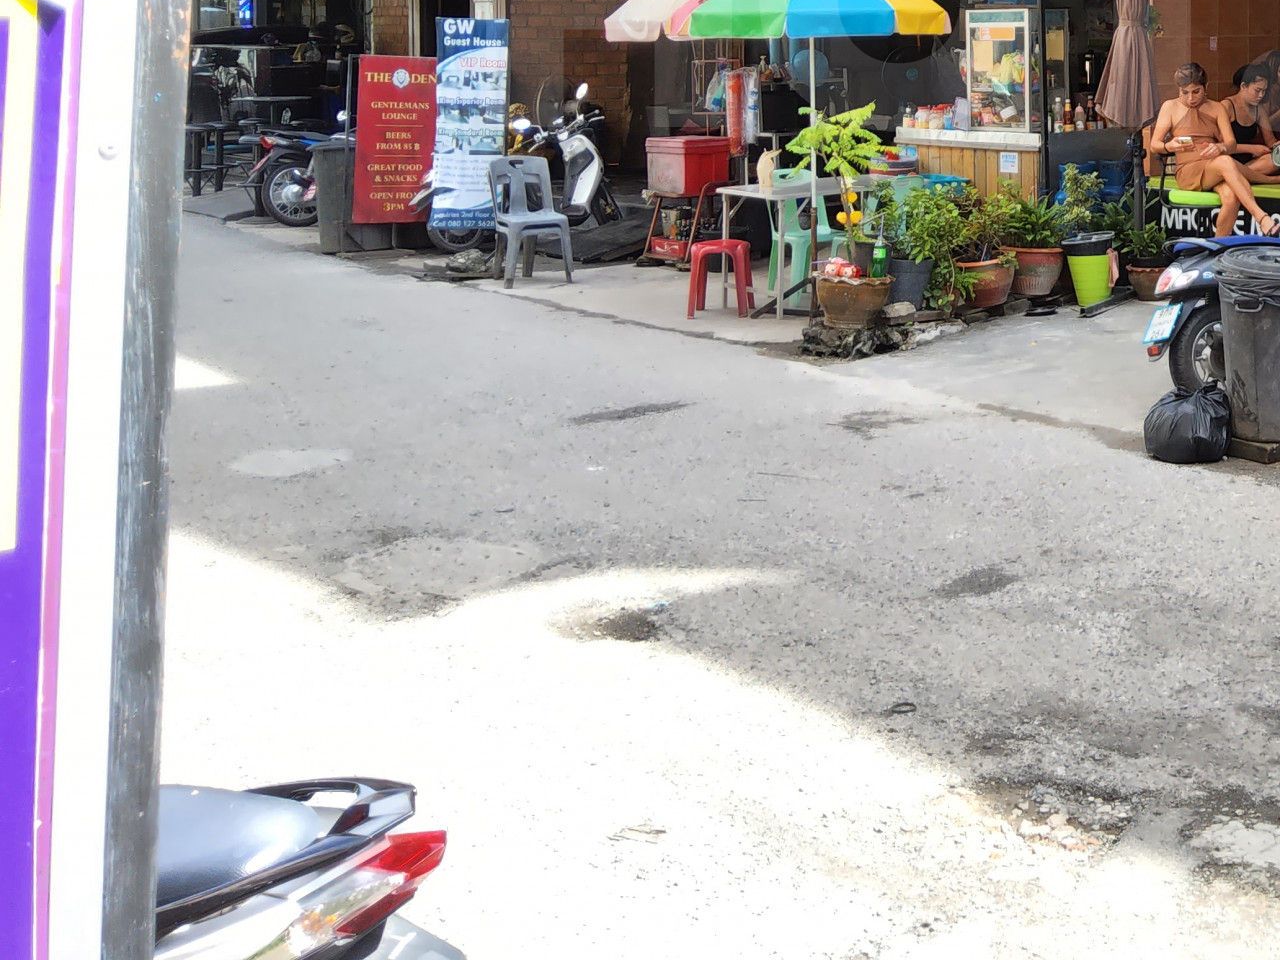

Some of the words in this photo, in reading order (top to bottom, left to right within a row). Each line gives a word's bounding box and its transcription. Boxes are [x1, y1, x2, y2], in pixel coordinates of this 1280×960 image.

[443, 18, 476, 35] GW
[443, 36, 471, 46] Guest
[473, 36, 502, 47] House
[460, 57, 478, 68] VIP
[480, 58, 506, 68] Room
[365, 71, 392, 83] THE
[411, 73, 437, 84] DEN
[371, 101, 430, 110] GENTLEMANS
[382, 112, 418, 120] LOUNGE
[386, 131, 412, 139] BEERS
[376, 142, 401, 150] FROM
[367, 164, 396, 172] GREAT
[398, 164, 423, 172] FOOD
[374, 174, 382, 182] &
[369, 191, 394, 200] OPEN
